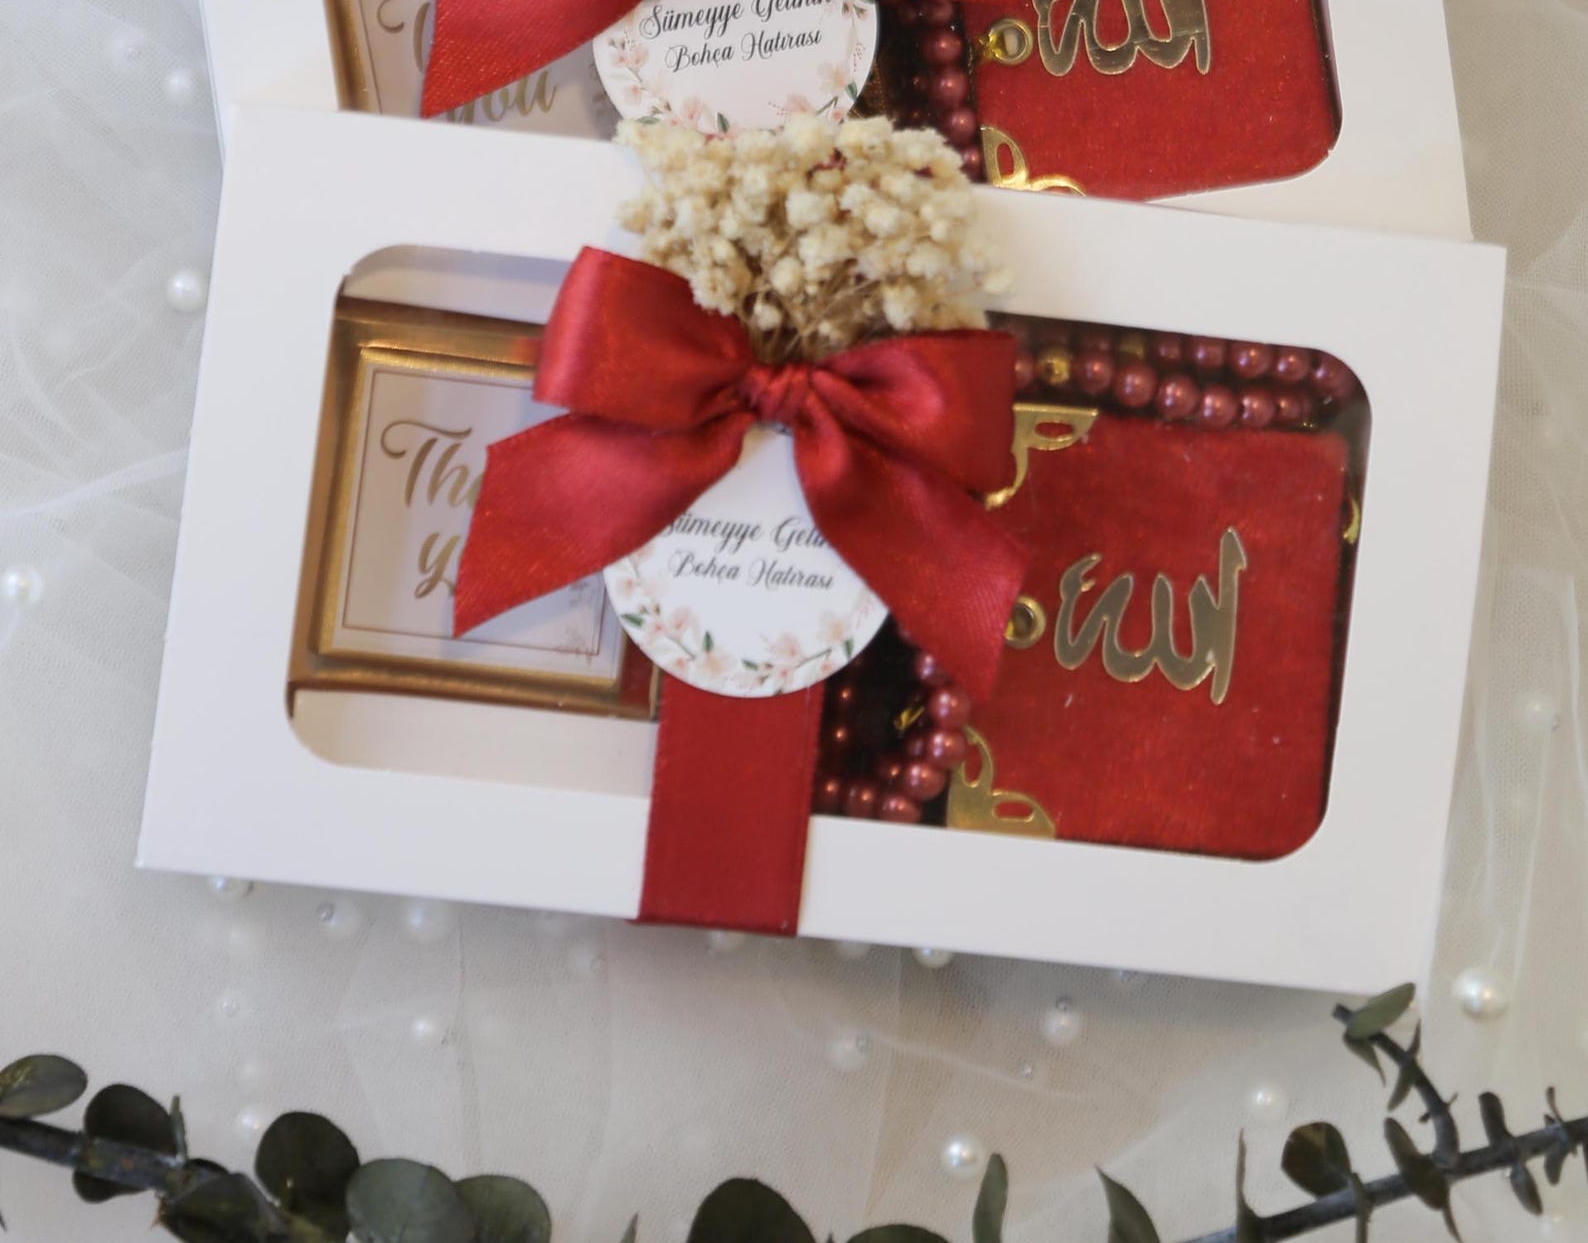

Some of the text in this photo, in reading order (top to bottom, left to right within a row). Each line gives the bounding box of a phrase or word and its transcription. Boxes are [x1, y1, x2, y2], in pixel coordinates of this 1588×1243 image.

[638, 2, 744, 40] Sümeyye
[664, 28, 823, 72] Bohça Hatırası
[661, 512, 763, 554] ümeyye
[667, 549, 834, 590] Bohça Hatırası
